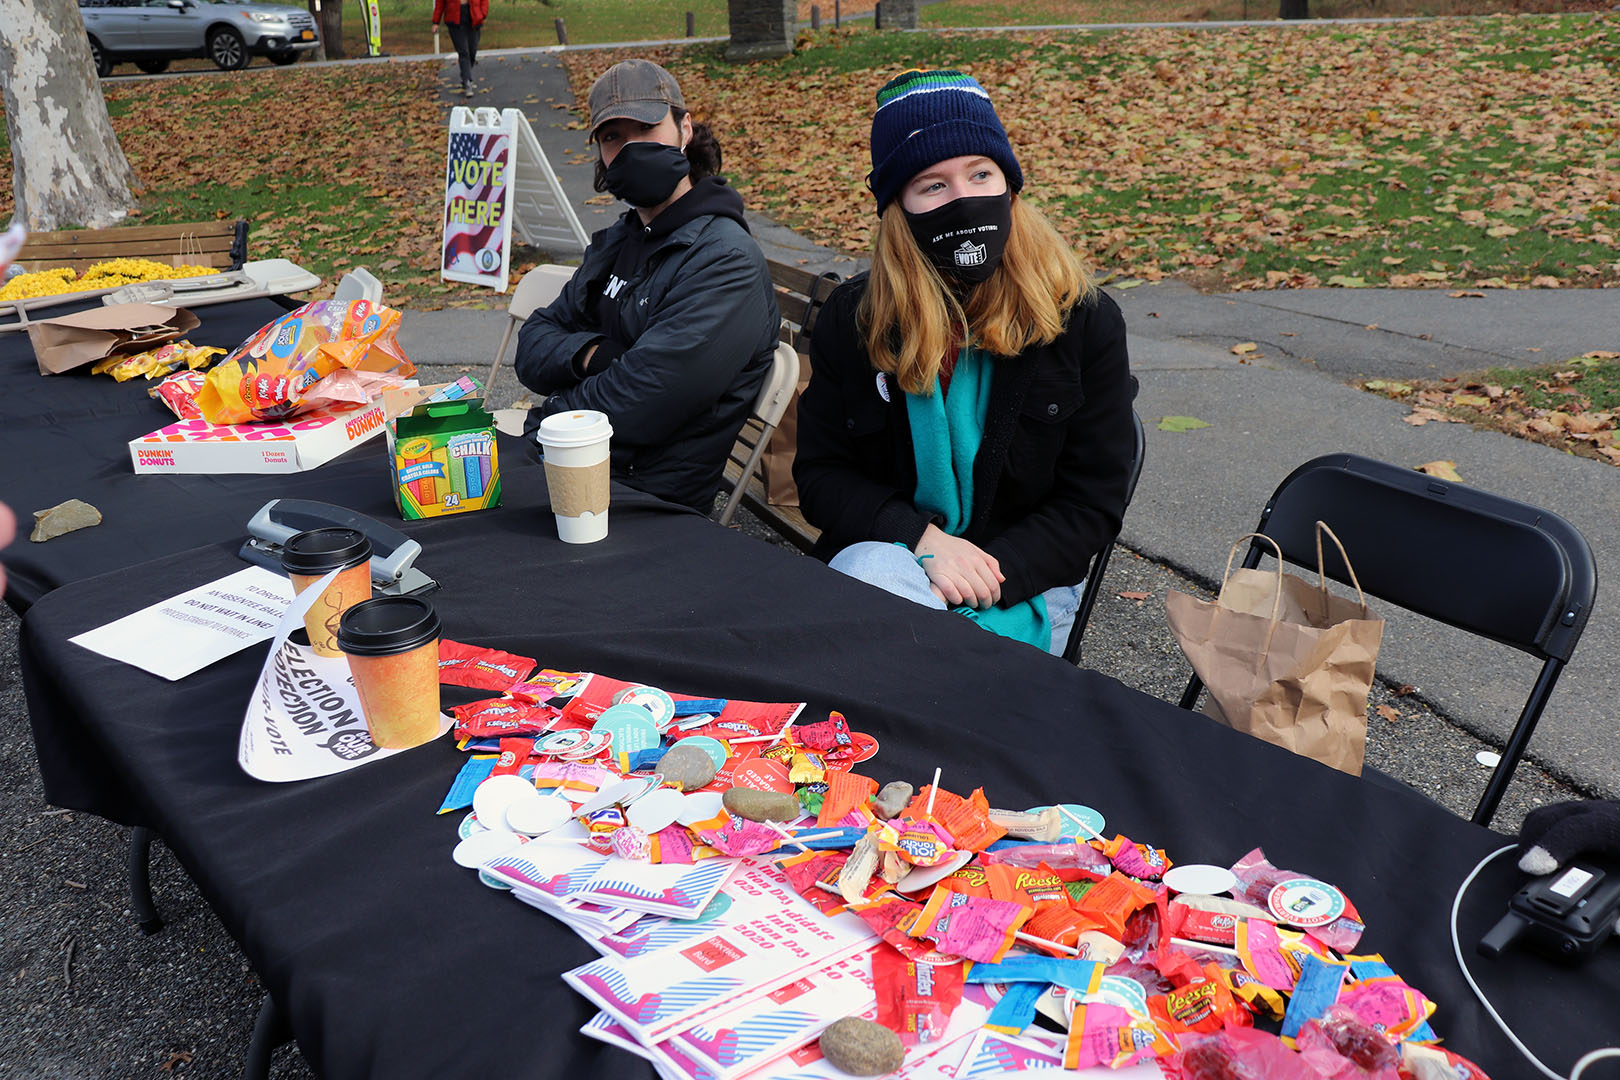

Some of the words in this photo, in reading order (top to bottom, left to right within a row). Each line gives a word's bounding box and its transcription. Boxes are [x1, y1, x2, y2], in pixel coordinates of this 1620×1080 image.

[453, 159, 505, 187] VOTE
[450, 199, 501, 227] HERE
[932, 235, 943, 244] ASK
[956, 228, 976, 236] ABOUT
[977, 225, 998, 233] VOTING!
[958, 252, 979, 265] VOTE
[346, 410, 385, 441] DUNKIN'
[138, 449, 174, 458] DUNKIN'
[452, 440, 492, 459] CHALK
[139, 457, 175, 466] DONUTS
[444, 494, 460, 507] 24
[207, 590, 221, 598] AN
[219, 593, 261, 609] ABSENTEE
[256, 586, 284, 602] DROP
[184, 599, 198, 608] DO
[198, 602, 216, 612] NOT
[215, 605, 239, 620] WAIT
[245, 616, 275, 631] LINE!
[274, 647, 329, 736] OTECTION
[284, 641, 360, 729] ELECTION
[332, 742, 360, 760] VOTE
[338, 733, 373, 754] OUR
[745, 769, 776, 792] NGAGED
[744, 870, 771, 892] tion
[758, 862, 788, 884] Info
[732, 878, 764, 897] 020
[764, 913, 800, 936] Info
[731, 923, 776, 951] 2020
[749, 919, 781, 942] tion
[781, 939, 812, 960] Day
[691, 950, 717, 967] Bard
[708, 936, 742, 962] Election
[1166, 982, 1218, 1014] Reese's
